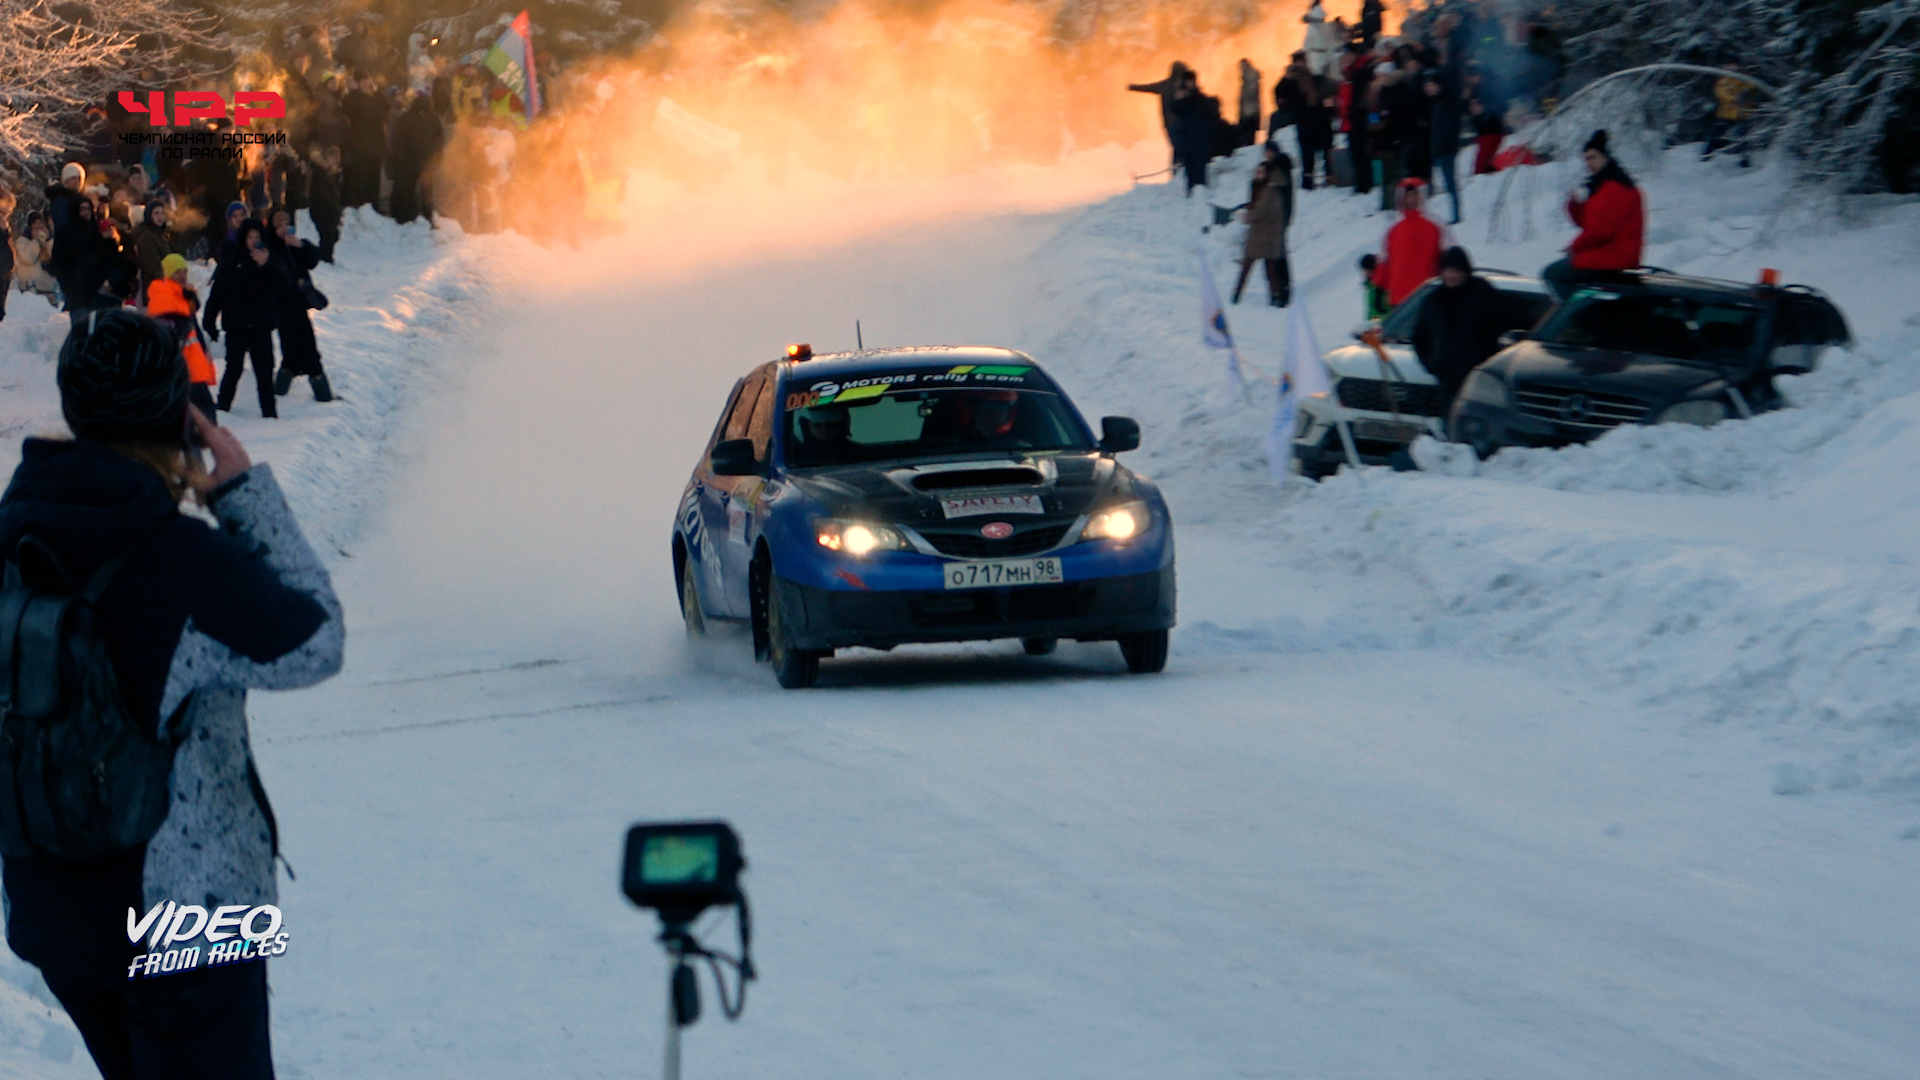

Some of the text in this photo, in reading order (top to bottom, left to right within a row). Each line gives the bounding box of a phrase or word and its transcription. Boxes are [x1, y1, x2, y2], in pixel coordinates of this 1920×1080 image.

[841, 374, 916, 390] MOTORS
[922, 373, 968, 383] rally
[975, 373, 1024, 383] team
[946, 495, 1033, 508] SAFETY
[1036, 560, 1055, 575] 98
